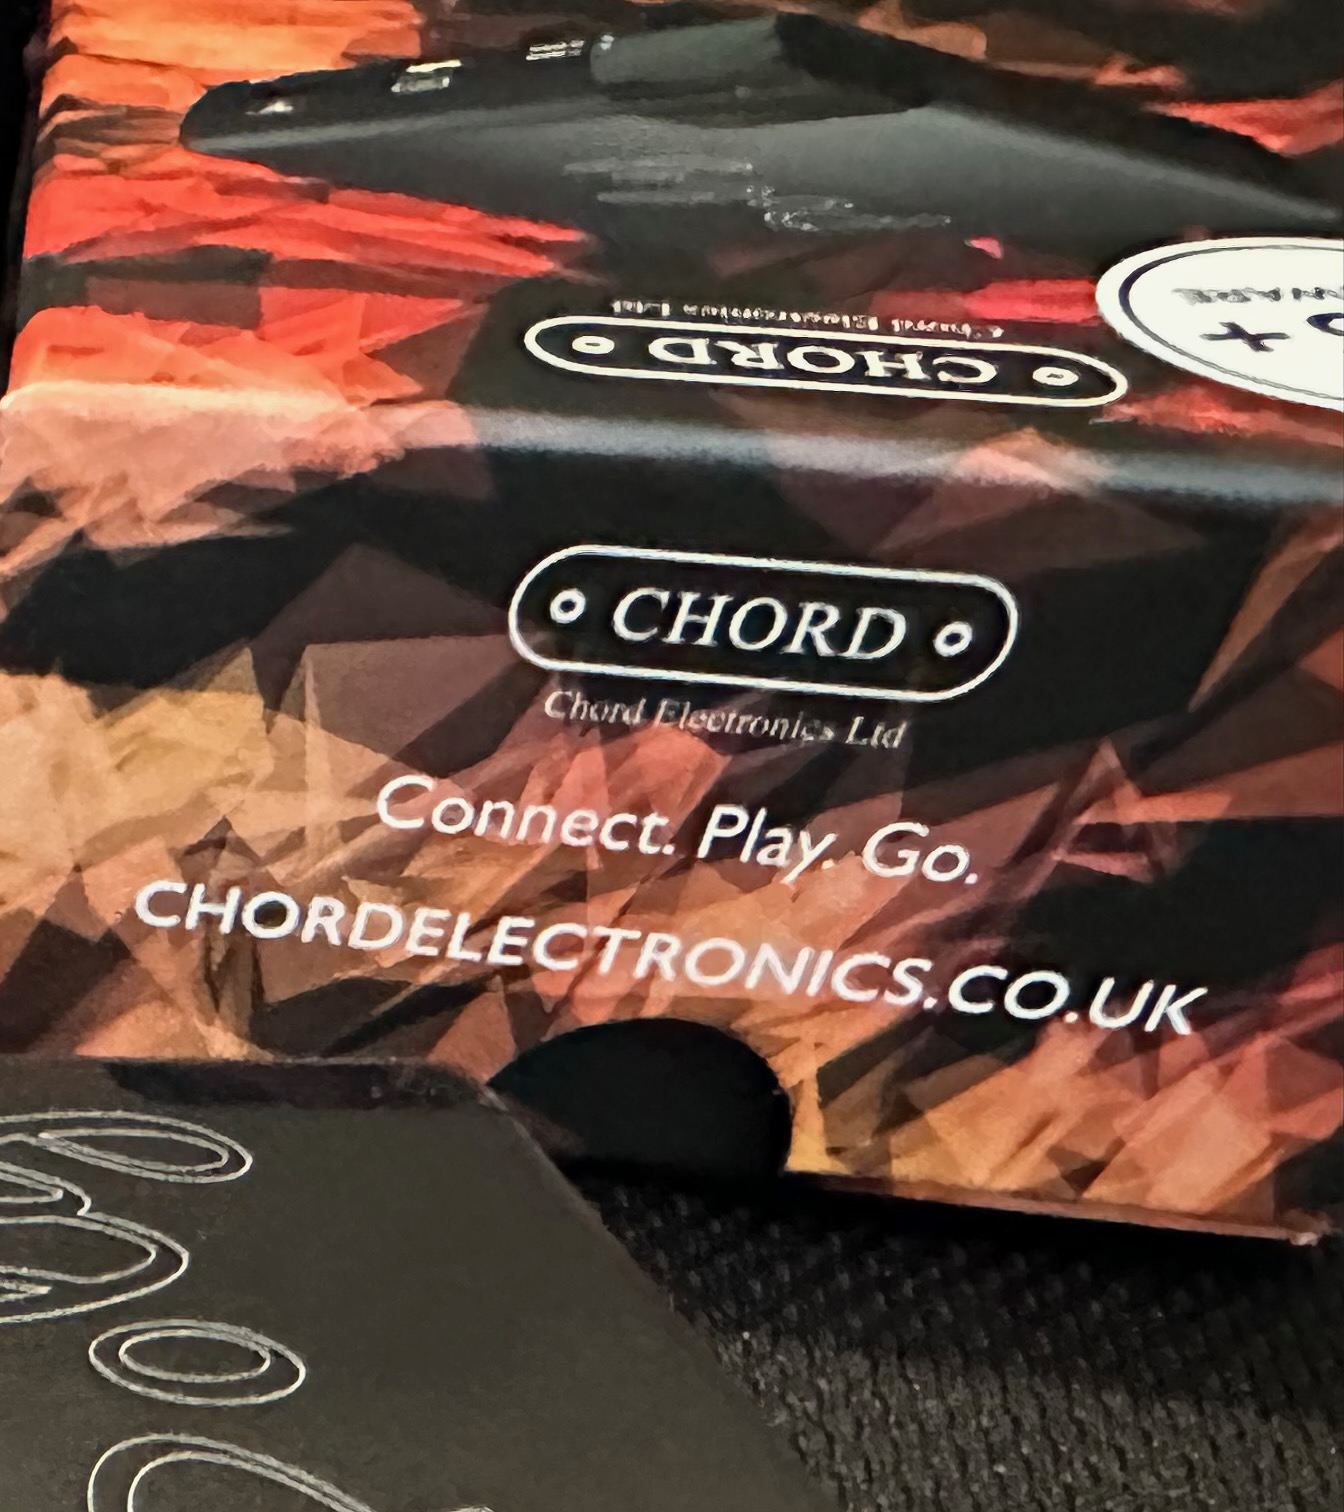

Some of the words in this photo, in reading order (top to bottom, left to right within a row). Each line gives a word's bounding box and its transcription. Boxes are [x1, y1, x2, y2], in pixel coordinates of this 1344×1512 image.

[647, 336, 1000, 384] CHORD
[611, 586, 908, 664] CHORD
[543, 690, 648, 727] Chord
[652, 698, 836, 743] Electronics
[844, 714, 909, 750] Ltd
[376, 774, 677, 856] Connect.
[696, 804, 838, 884] Play.
[861, 821, 979, 885] Go.
[134, 879, 1209, 1036] CHORDELECTRONICS.CO.UK
